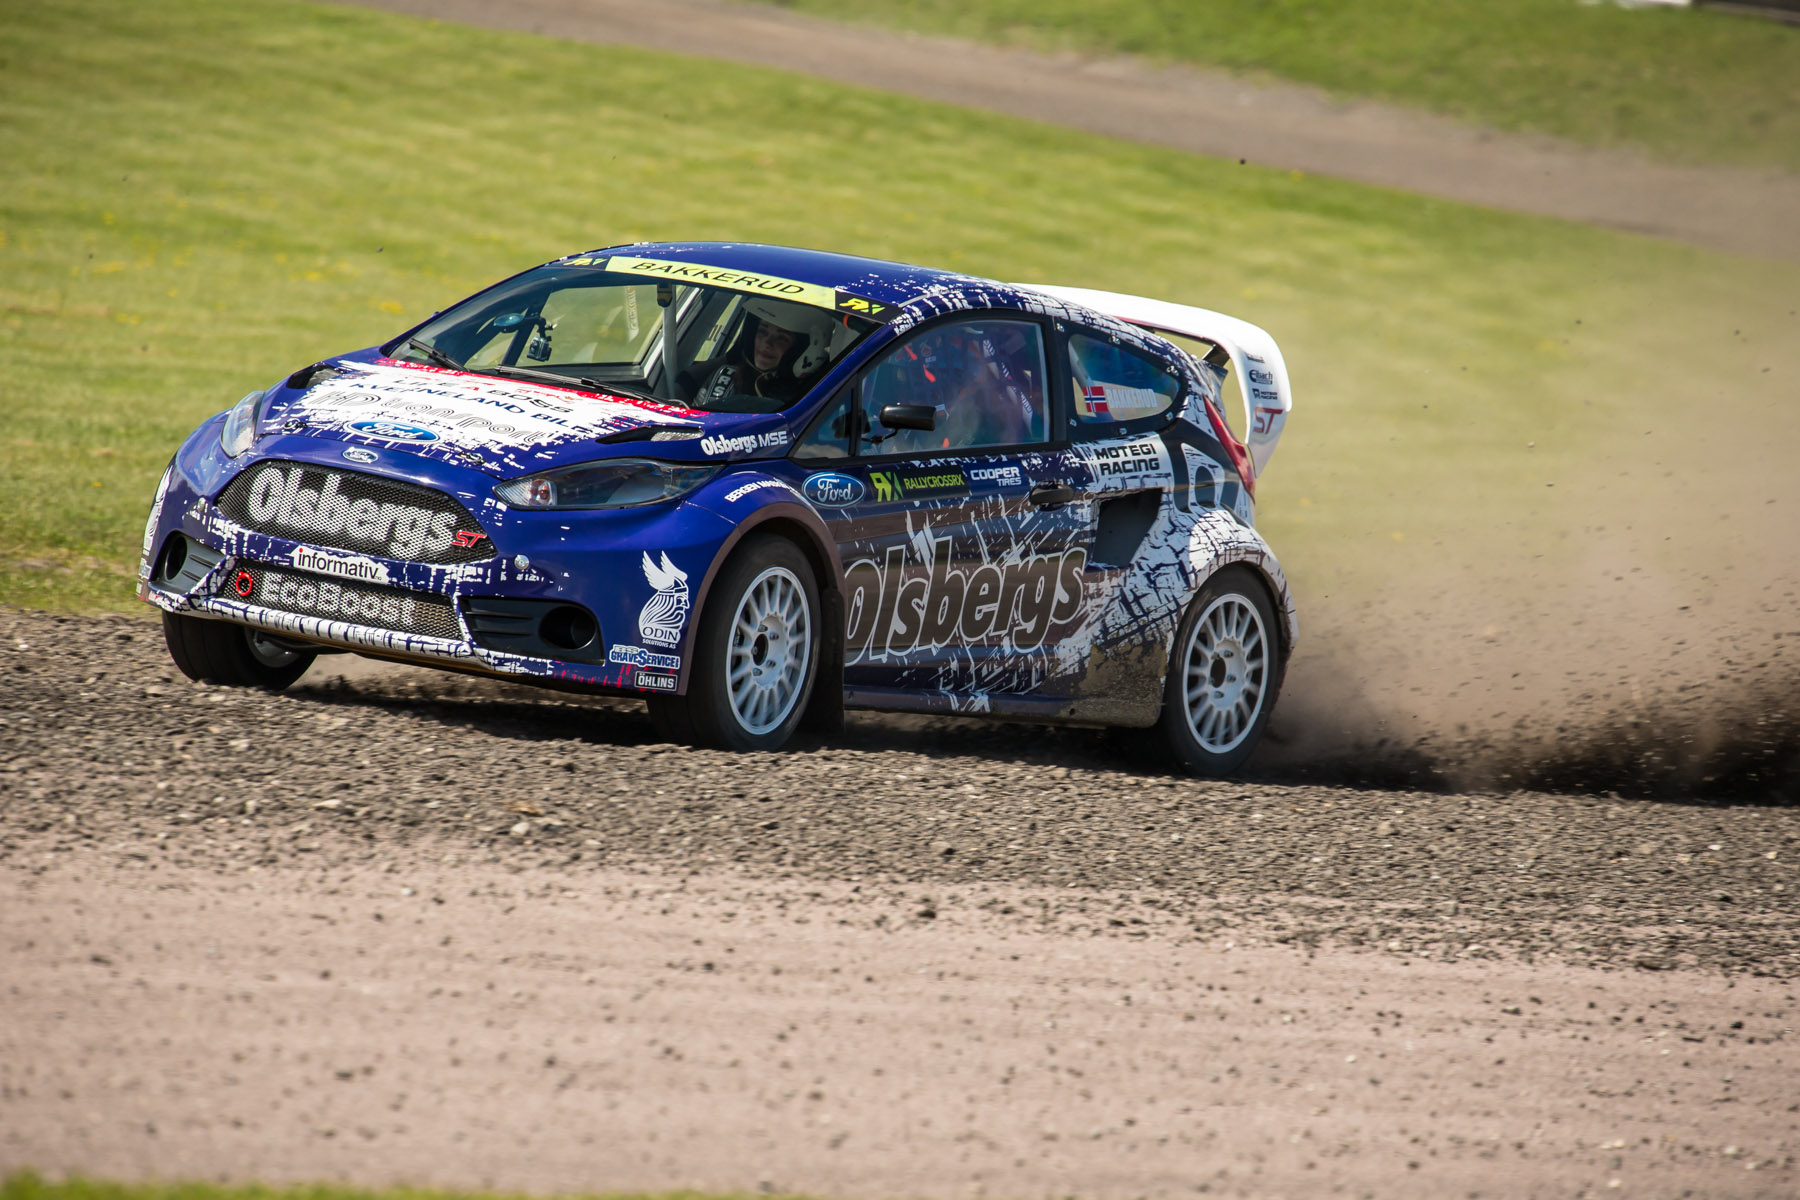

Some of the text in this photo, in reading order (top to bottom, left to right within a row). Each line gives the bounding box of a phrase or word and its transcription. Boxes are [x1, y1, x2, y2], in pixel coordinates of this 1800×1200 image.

[631, 261, 806, 296] BAKKERUD
[487, 389, 574, 413] BOSS
[1253, 406, 1284, 435] ST
[361, 422, 424, 440] Ford
[700, 430, 788, 456] Olsbergs MSE
[1093, 443, 1157, 461] MOTEGI
[969, 466, 1021, 481] COOPER
[1099, 457, 1160, 476] RACING
[817, 478, 854, 502] Ford
[903, 474, 965, 490] RALLYCROSSRX
[996, 476, 1022, 487] TIRES
[248, 467, 458, 561] Olsbergs
[451, 530, 488, 548] ST
[844, 535, 1088, 669] Olsbergs
[642, 626, 679, 642] ODIN
[642, 637, 669, 649] SOLUTIONS
[638, 672, 675, 688] ÖHLINS
